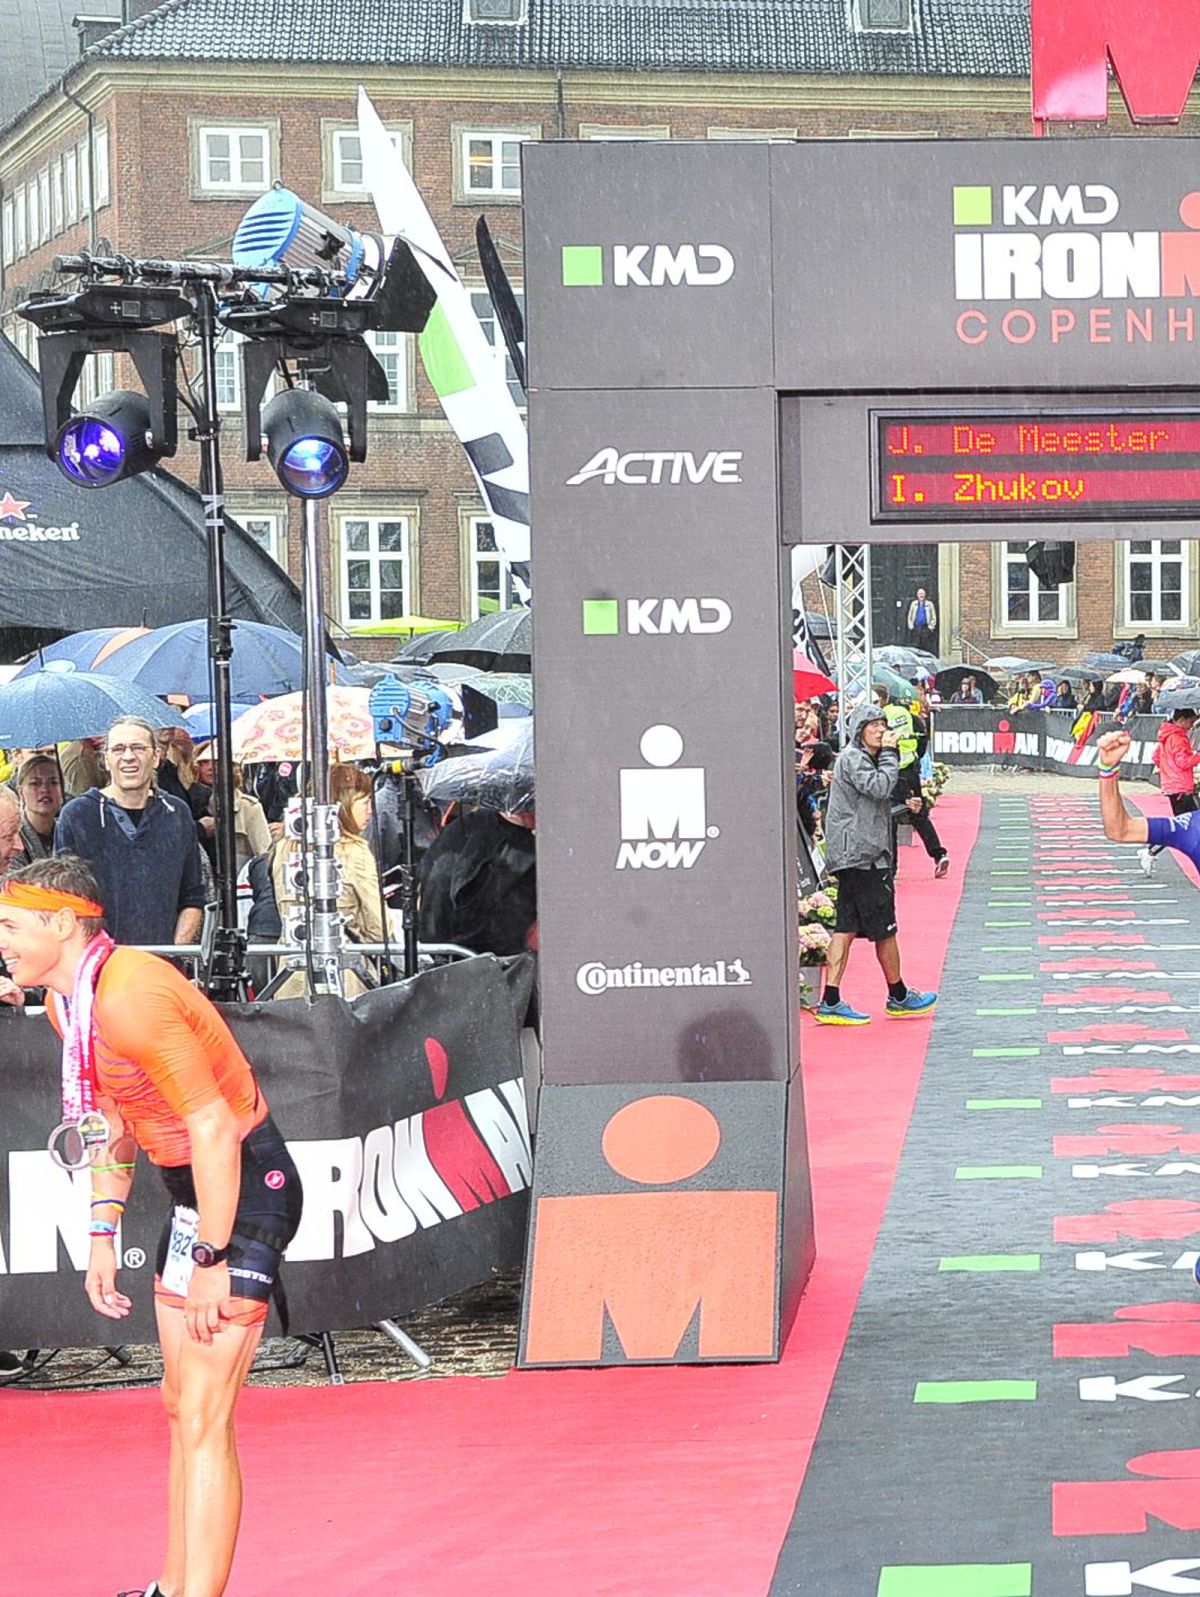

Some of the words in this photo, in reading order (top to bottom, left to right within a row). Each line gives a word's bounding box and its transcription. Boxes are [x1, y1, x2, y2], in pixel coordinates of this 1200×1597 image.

[1002, 184, 1120, 226] KMD
[613, 244, 735, 286] KMD
[887, 426, 924, 454] J.
[954, 425, 996, 453] De
[1018, 424, 1171, 453] Meester
[566, 447, 742, 485] ACTIVE
[891, 474, 925, 502] I.
[954, 473, 1085, 502] Zhukov
[626, 598, 732, 635] KMD
[935, 731, 1039, 756] IRONMAN
[615, 841, 706, 869] NOW
[576, 960, 725, 995] Continental
